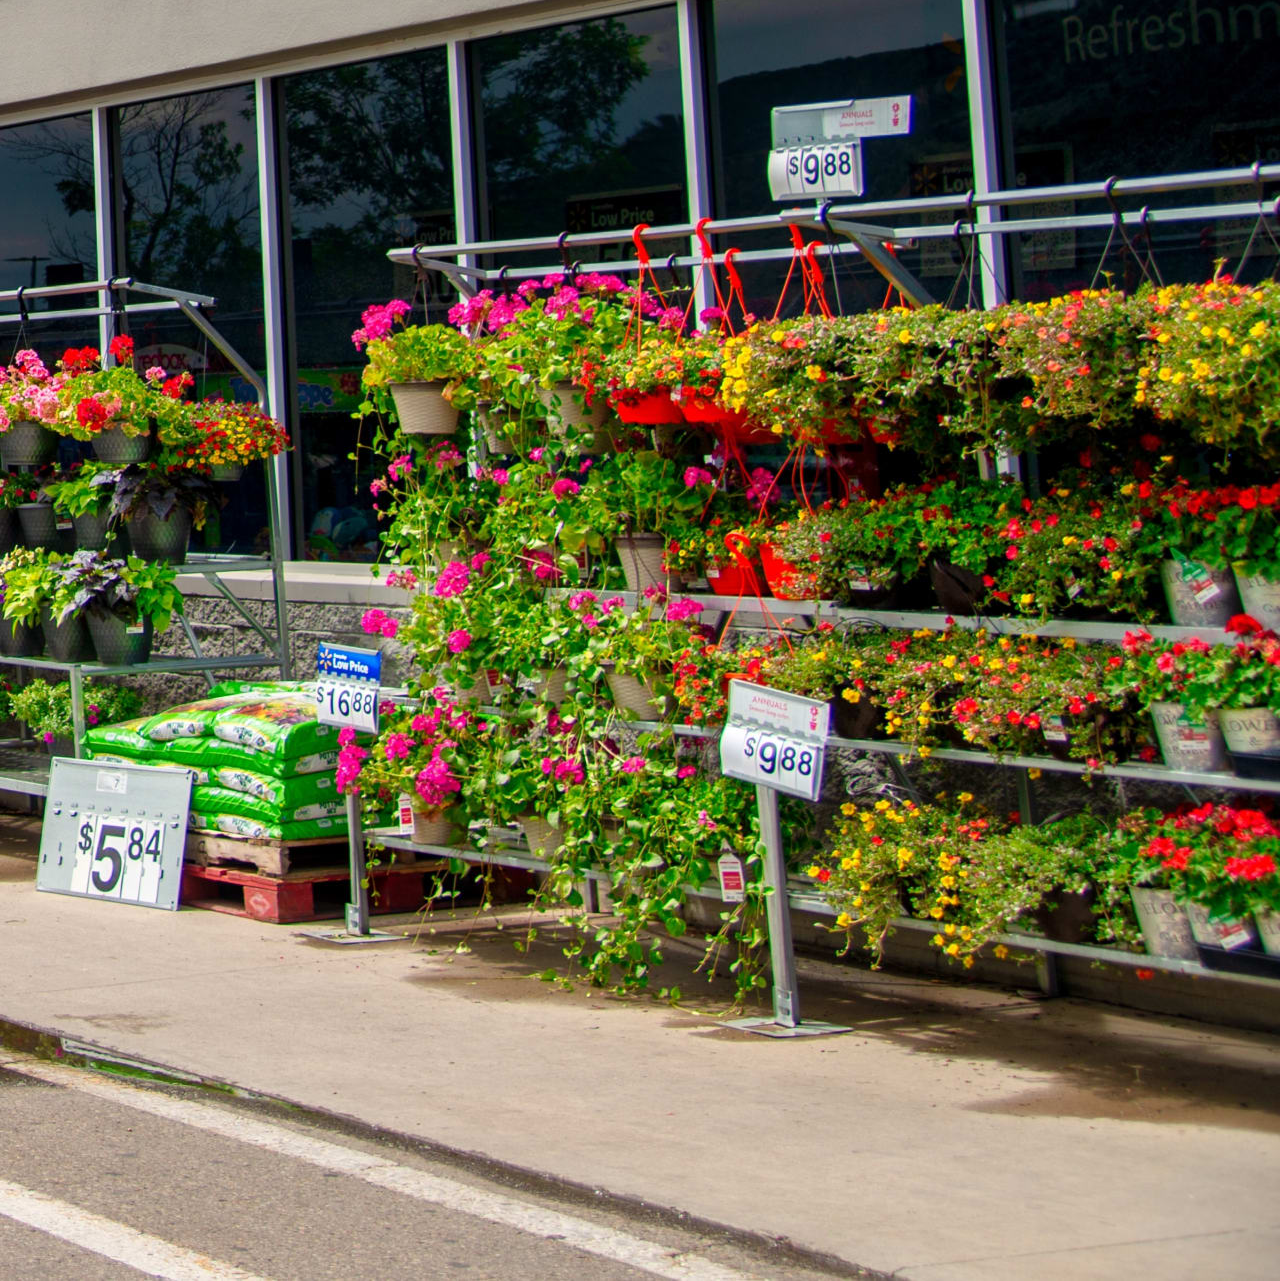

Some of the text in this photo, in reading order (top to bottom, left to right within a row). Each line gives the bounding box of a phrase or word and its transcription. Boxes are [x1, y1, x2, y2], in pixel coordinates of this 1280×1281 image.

[841, 109, 873, 119] ANNUALS
[591, 205, 655, 228] Low Price
[137, 347, 187, 368] redbox
[332, 657, 369, 674] Low Price
[752, 696, 788, 711] ANNUALS
